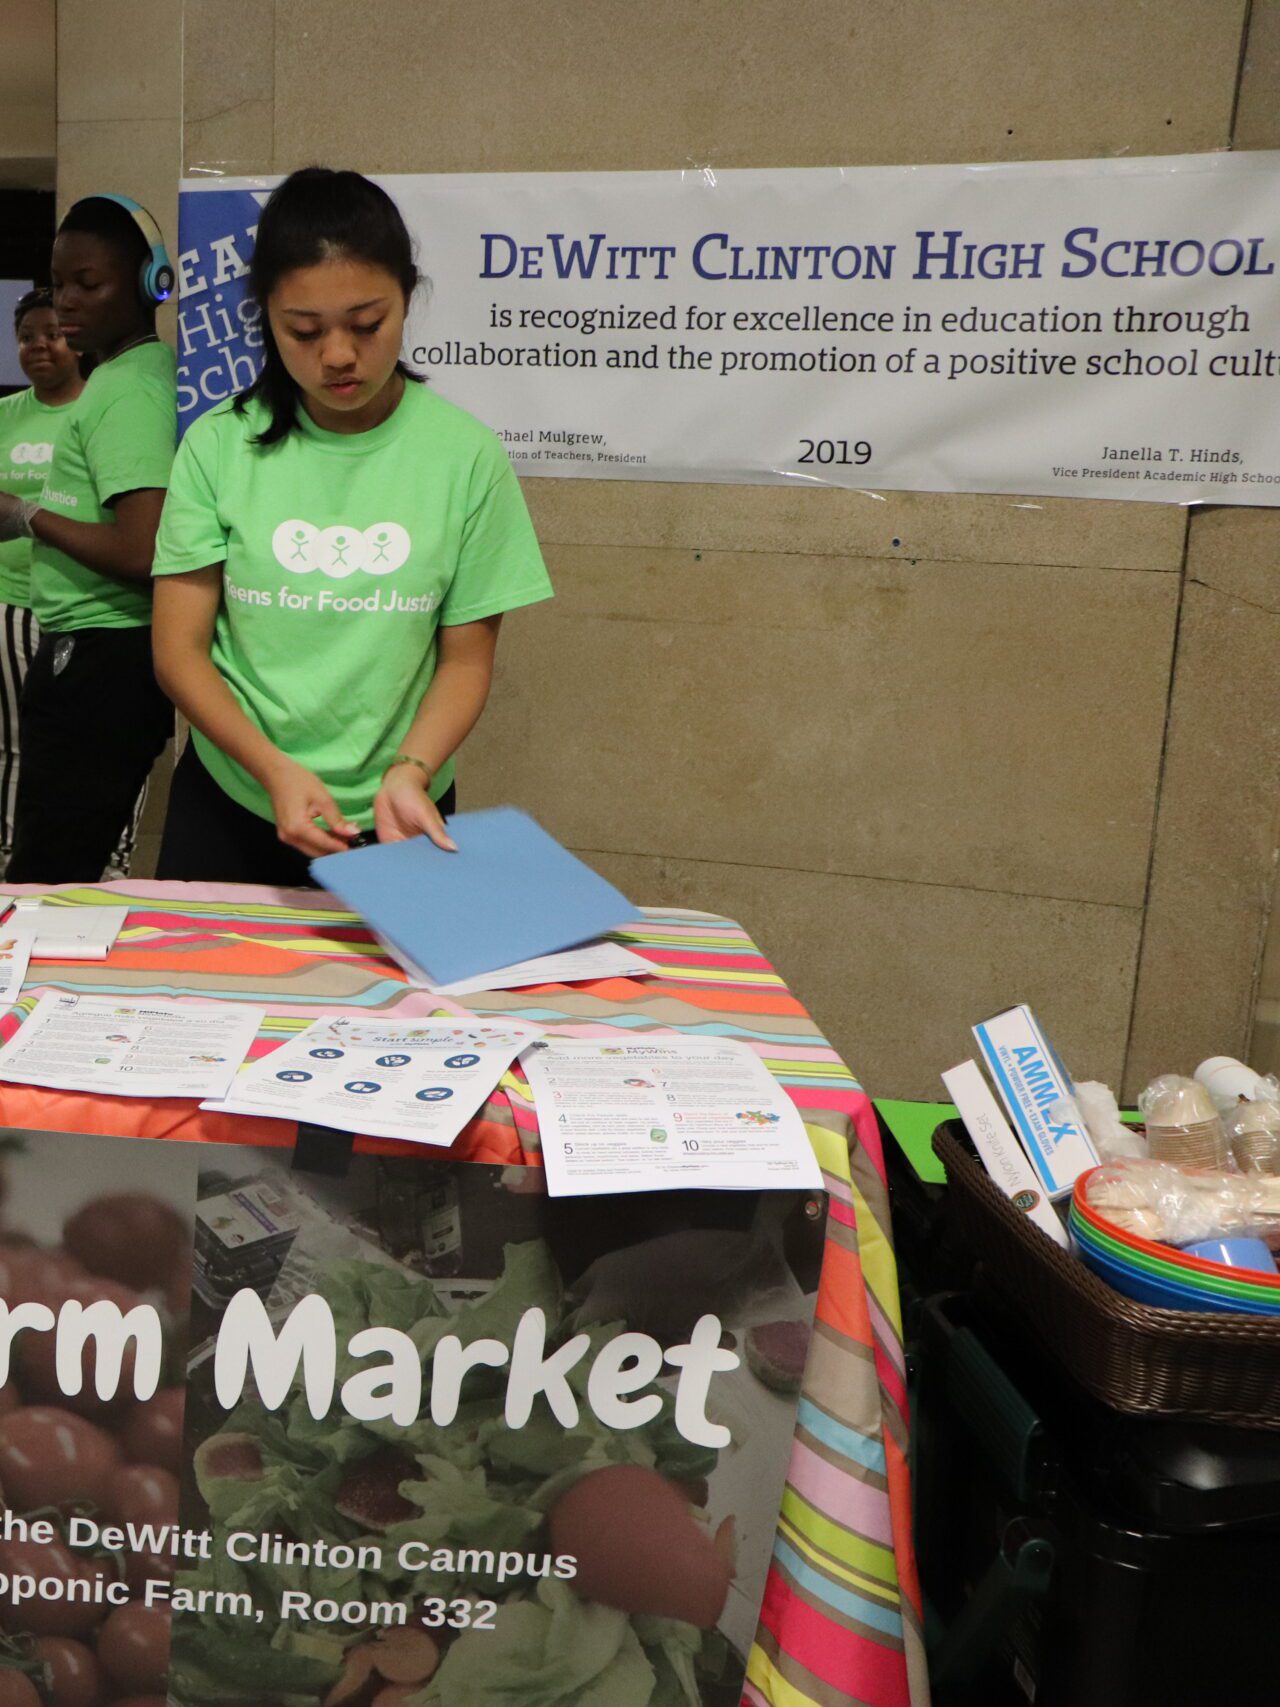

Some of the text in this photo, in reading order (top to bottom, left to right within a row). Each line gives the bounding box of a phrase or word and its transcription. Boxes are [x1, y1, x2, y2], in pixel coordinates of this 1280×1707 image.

[178, 223, 260, 301] EA
[489, 303, 1251, 339] is recognized for excellence in education through
[411, 342, 1280, 381] collaboration and the promotion of a positive school cult
[495, 429, 607, 447] chael Mulgrew,
[531, 451, 541, 460] of
[545, 451, 595, 463] Teachers,
[598, 453, 647, 464] President
[797, 438, 873, 465] 2019
[1101, 446, 1244, 465] Janella T. Hinds,
[1052, 467, 1078, 478] Vice
[1082, 468, 1140, 480] President
[1143, 470, 1206, 482] Academic
[1209, 472, 1238, 484] High
[278, 586, 313, 611] for
[318, 589, 380, 613] Food
[411, 1035, 454, 1044] simple
[558, 1113, 567, 1124] 4
[564, 1142, 573, 1154] 5
[682, 1139, 699, 1152] 10
[214, 1287, 741, 1449] Market
[68, 1517, 212, 1561] DeWitt
[225, 1531, 383, 1571] Clinton
[397, 1541, 579, 1584] Campus
[144, 1579, 265, 1624] Farm,
[280, 1590, 408, 1627] Room
[421, 1598, 498, 1631] 332
